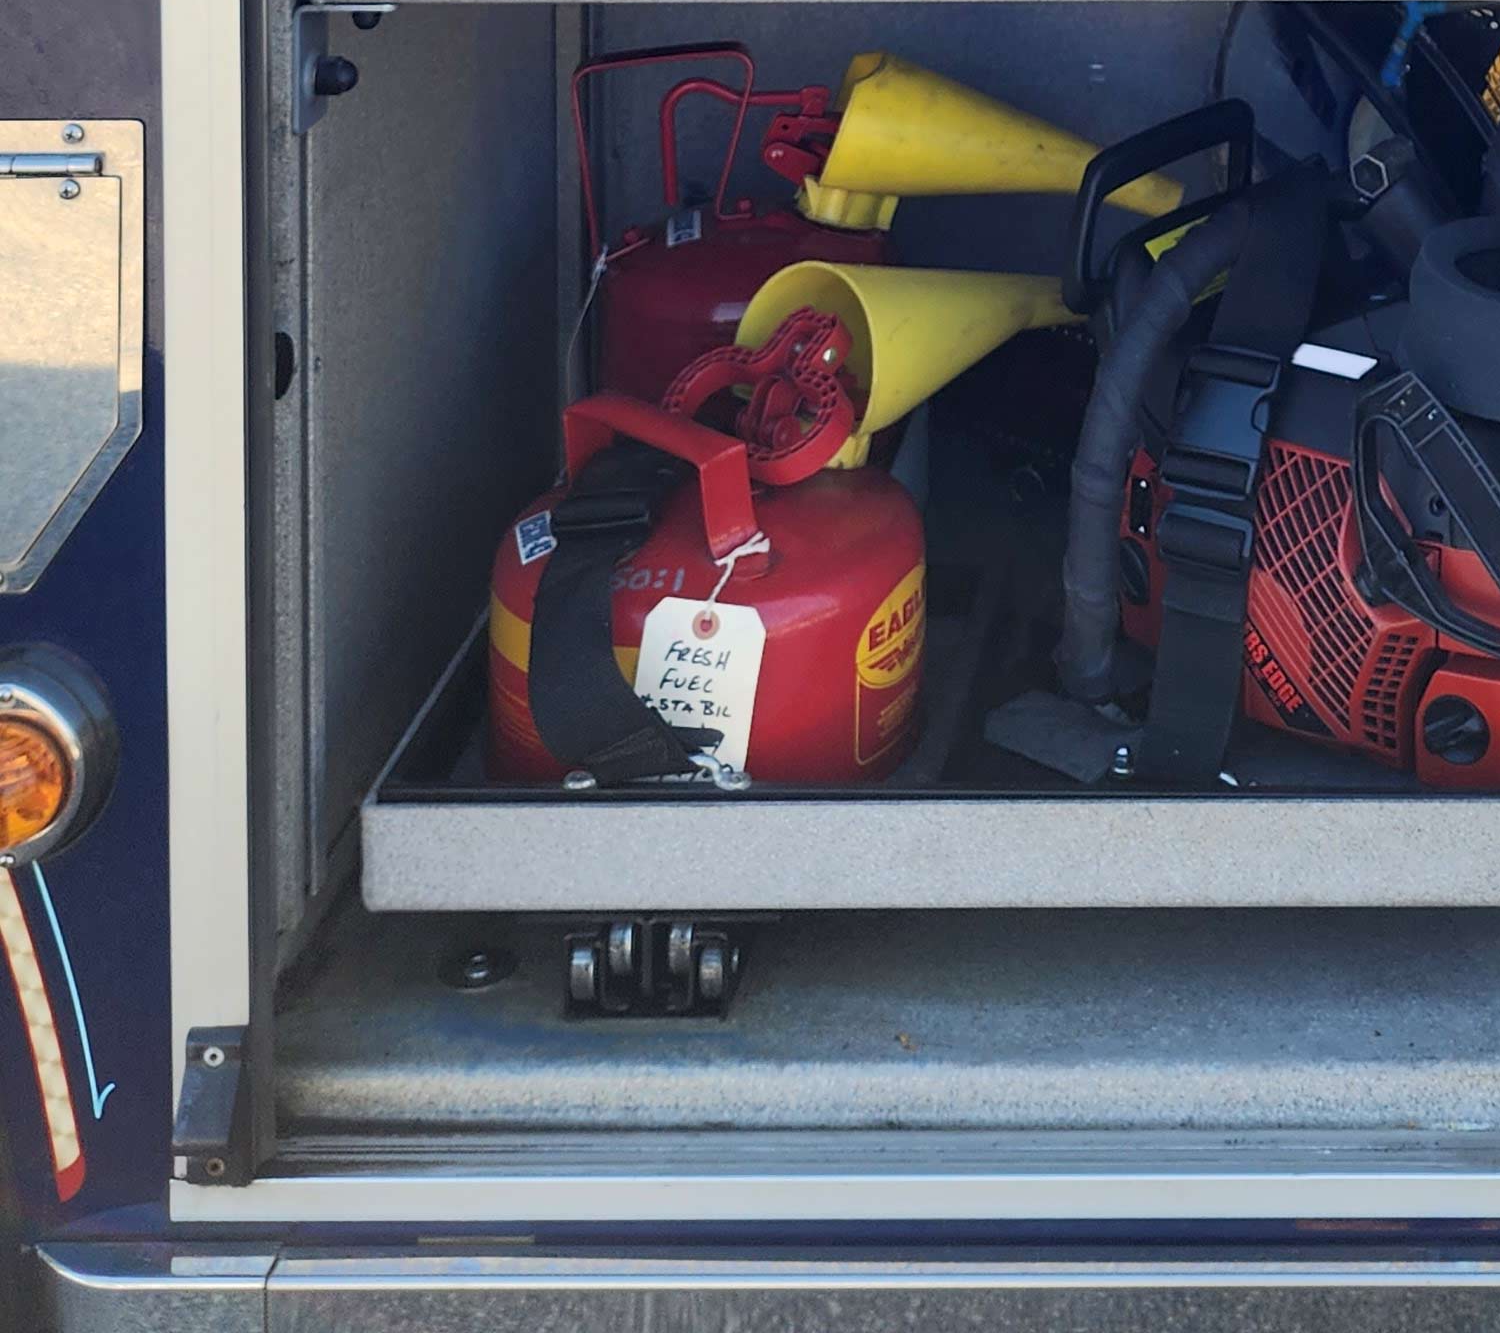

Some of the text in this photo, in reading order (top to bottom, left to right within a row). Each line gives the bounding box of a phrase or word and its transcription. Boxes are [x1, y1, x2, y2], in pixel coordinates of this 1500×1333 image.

[664, 640, 732, 672] FRESH
[658, 668, 714, 694] FUEL
[1261, 659, 1304, 714] EDGE
